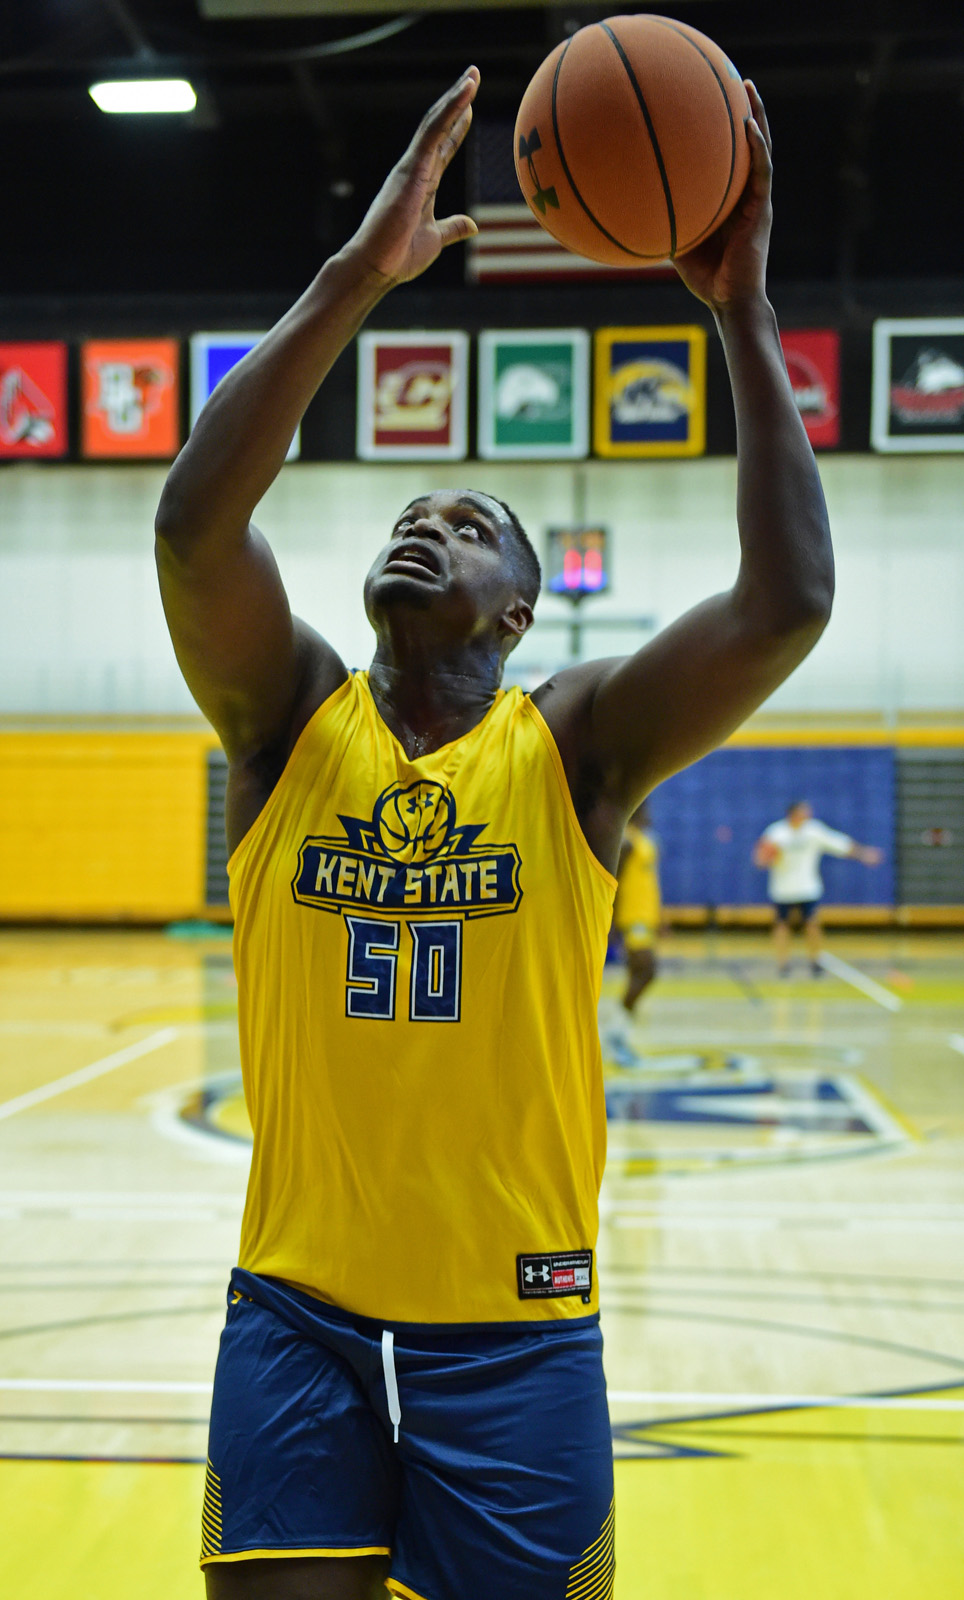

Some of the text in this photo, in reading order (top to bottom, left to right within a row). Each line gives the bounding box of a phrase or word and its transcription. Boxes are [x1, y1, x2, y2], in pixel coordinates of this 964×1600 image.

[315, 852, 498, 904] KENT STATE
[344, 914, 463, 1022] 50
